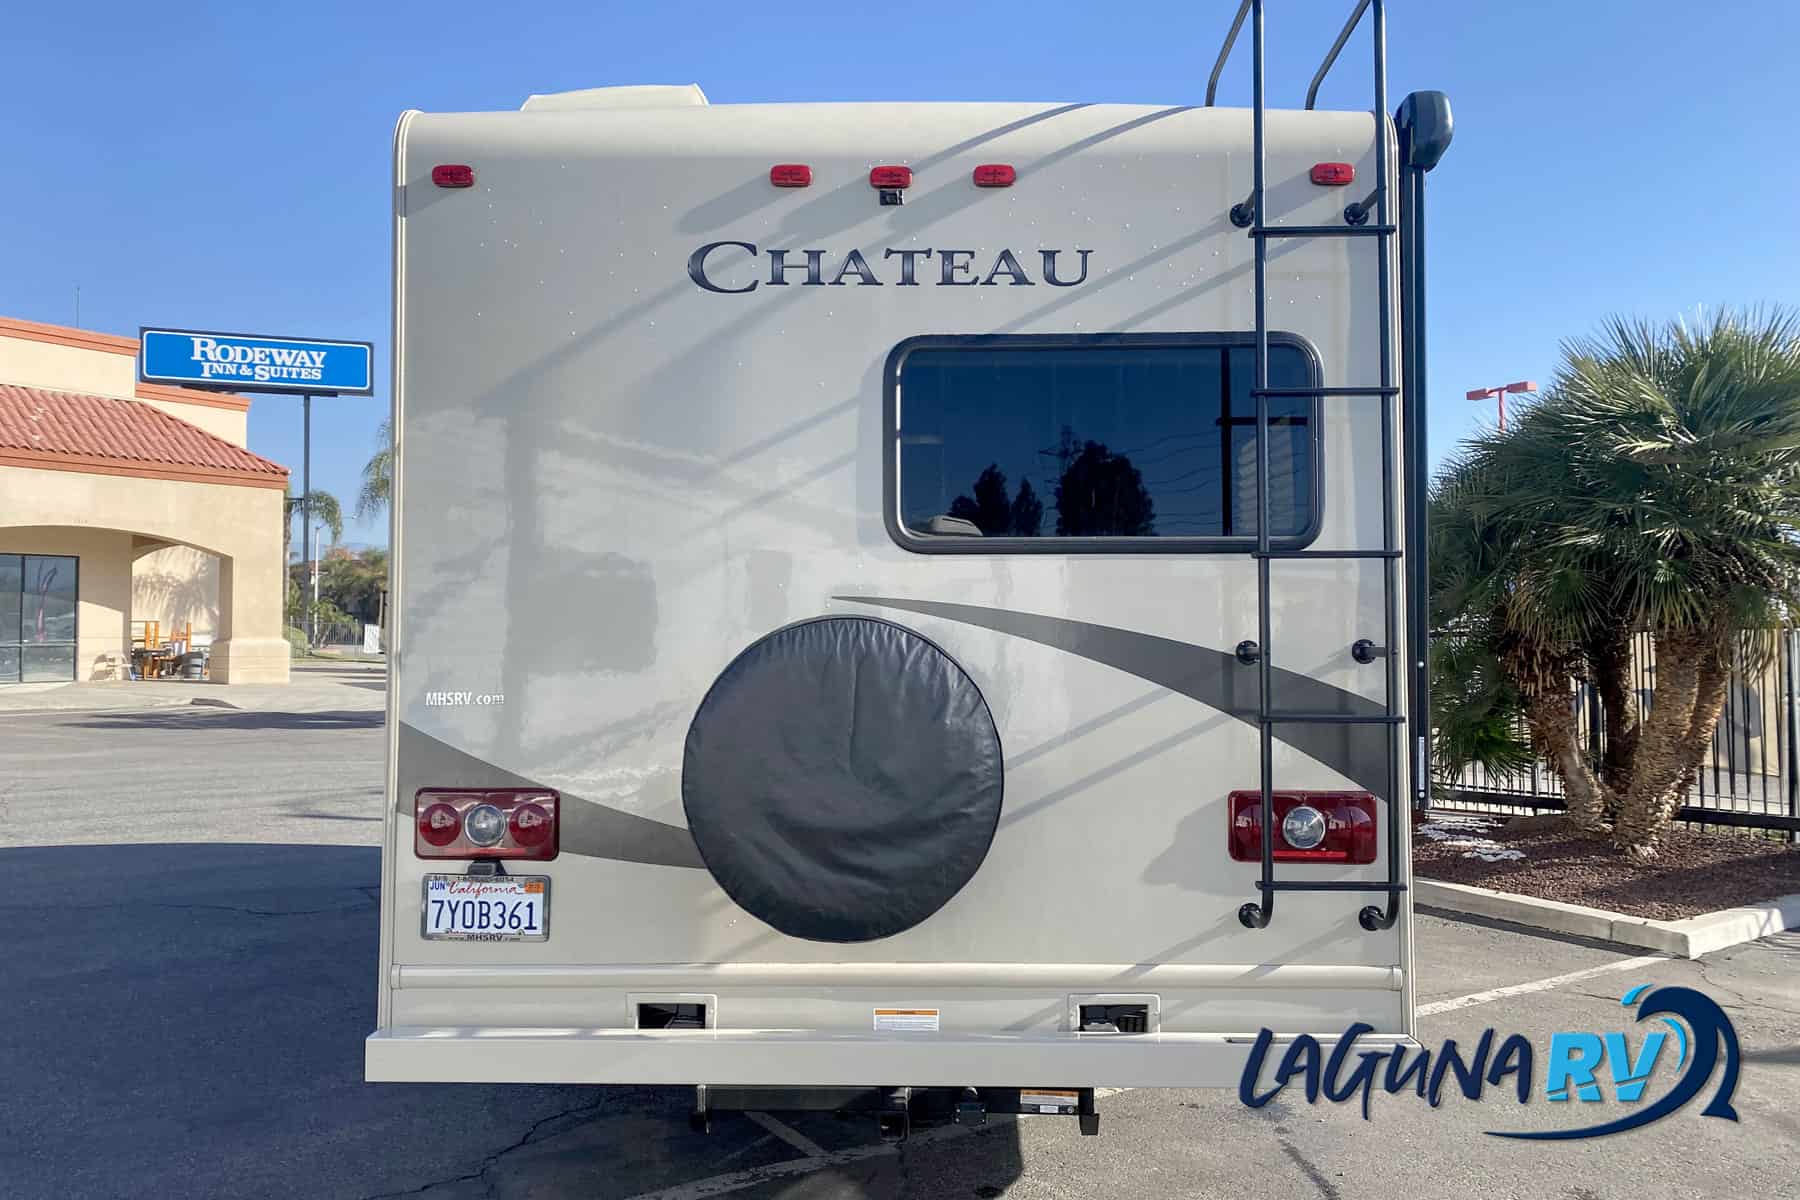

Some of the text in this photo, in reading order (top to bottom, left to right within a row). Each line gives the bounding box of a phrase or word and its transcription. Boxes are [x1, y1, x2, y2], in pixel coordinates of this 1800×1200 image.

[688, 240, 1094, 294] CHATEAU
[191, 337, 327, 368] RODEWAY
[201, 361, 322, 381] INN & SUITES
[425, 691, 504, 705] MHSRV.com
[430, 880, 446, 890] JUN
[448, 880, 518, 897] California
